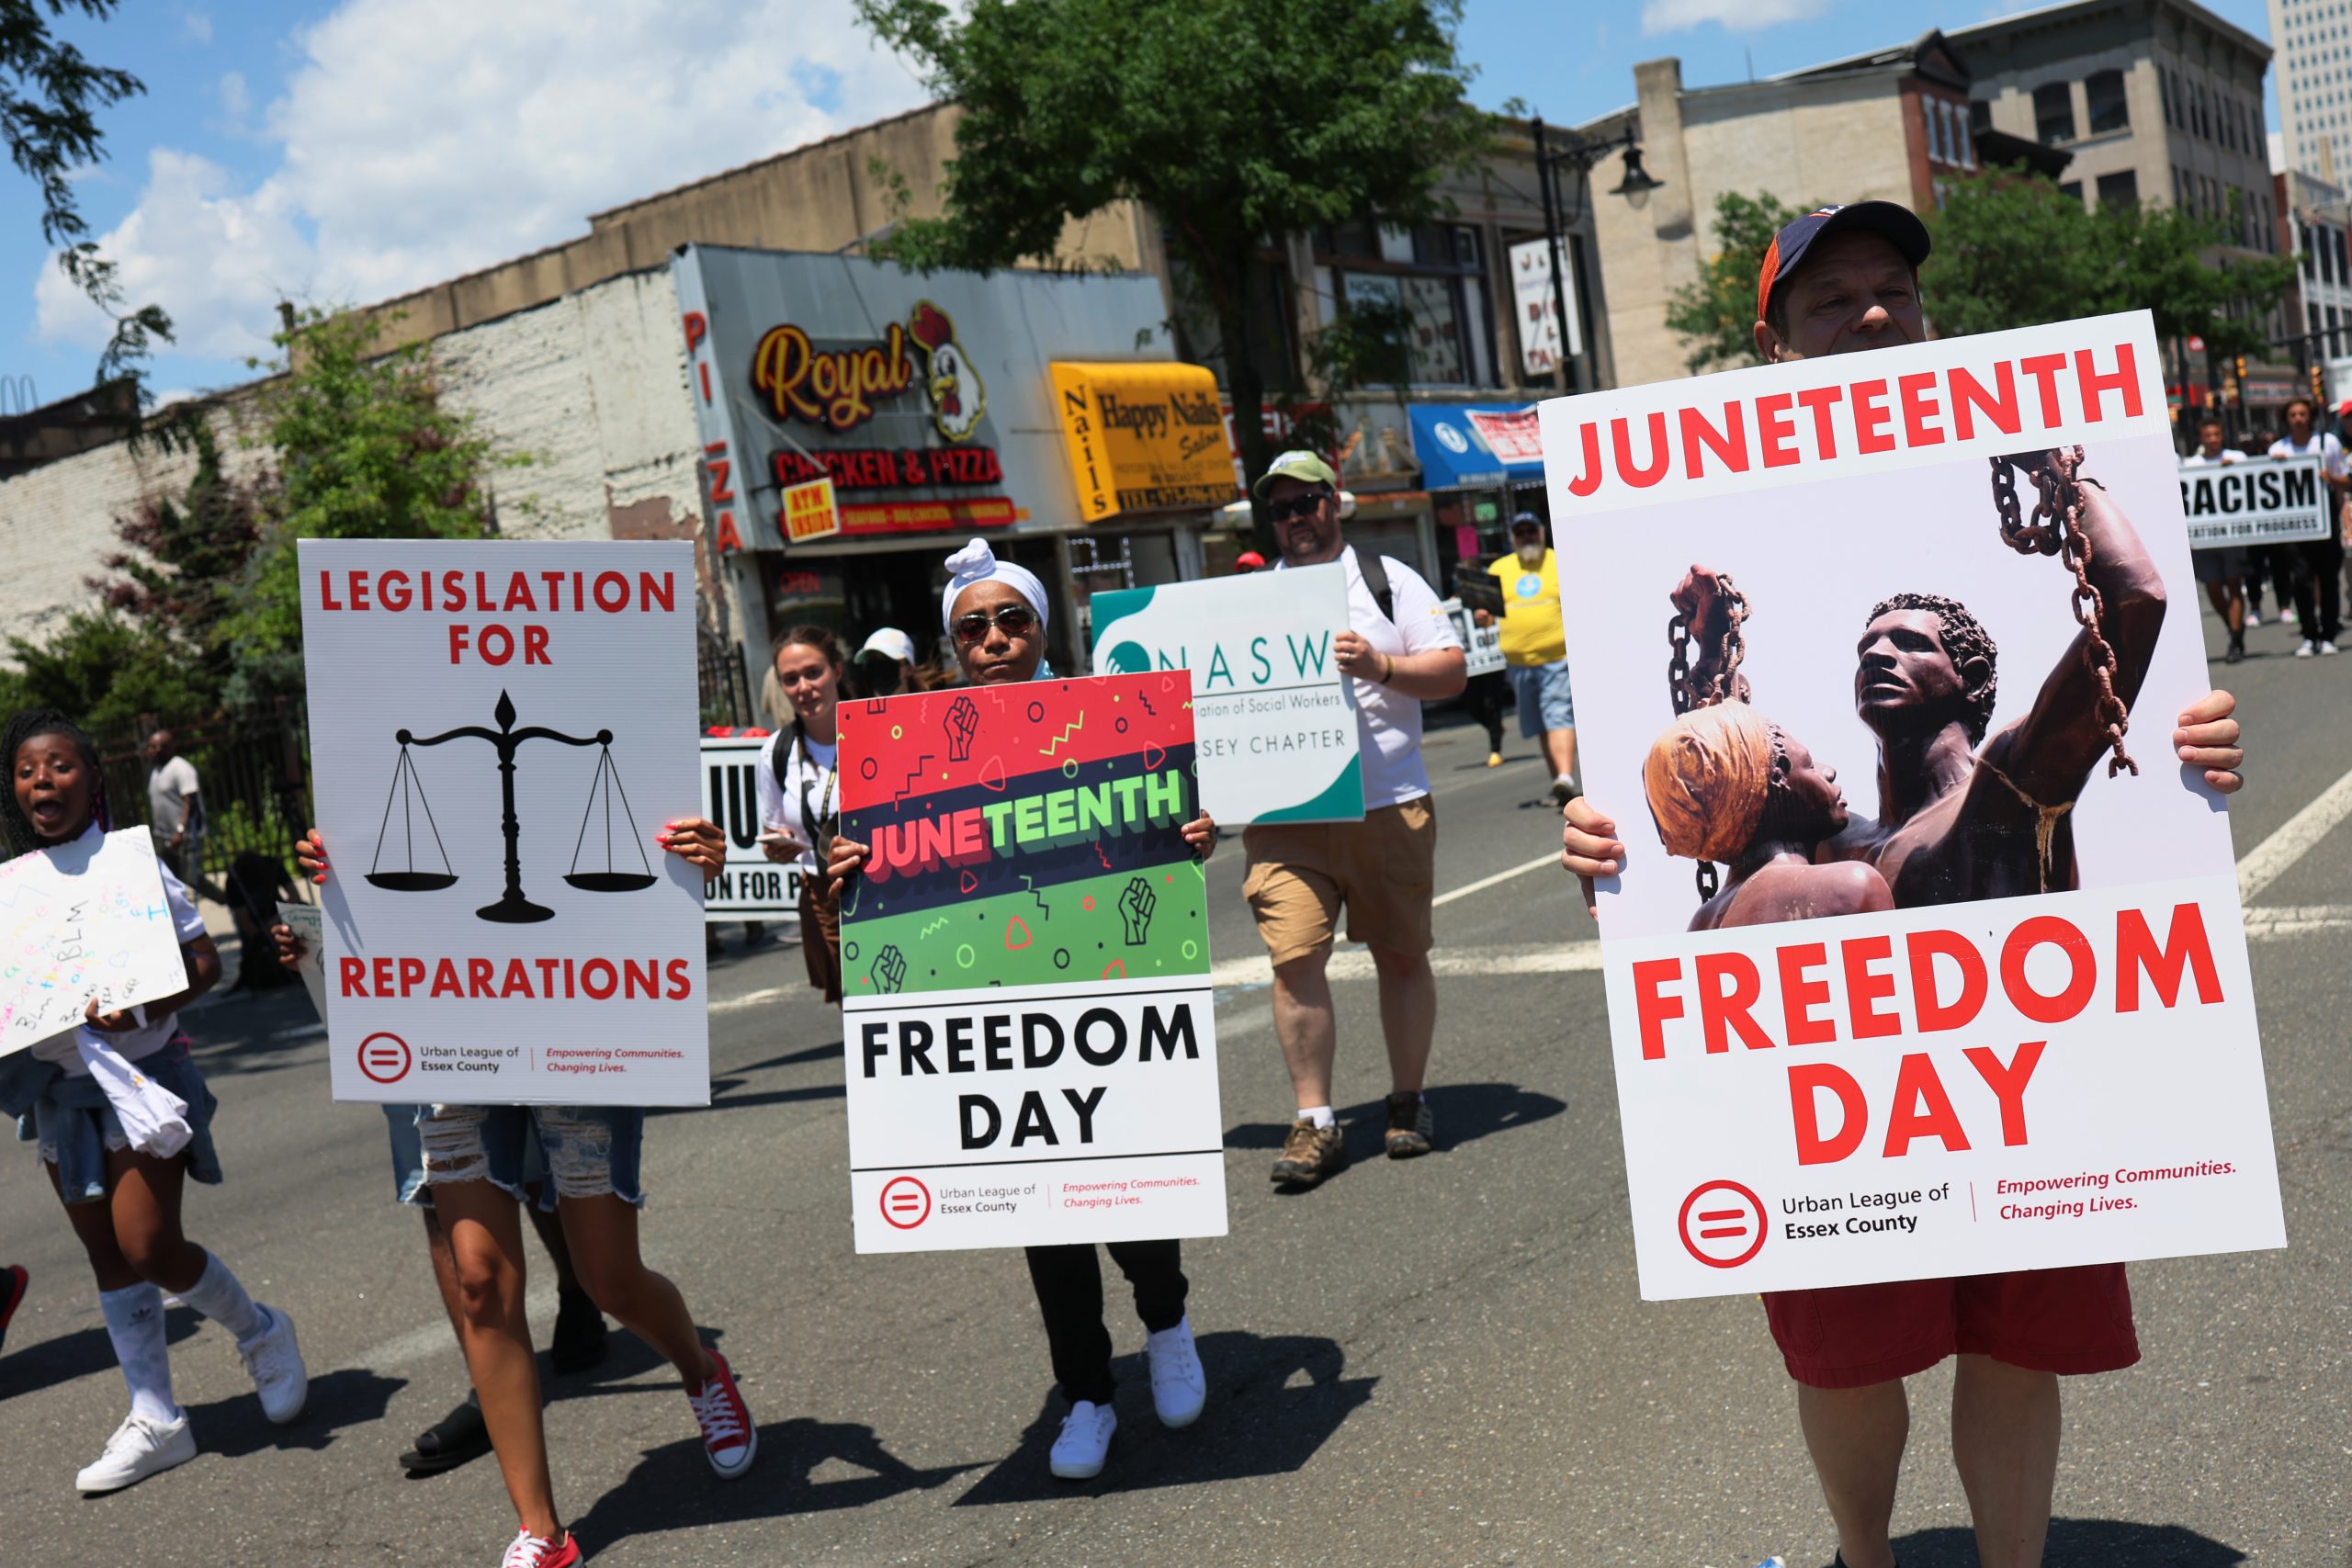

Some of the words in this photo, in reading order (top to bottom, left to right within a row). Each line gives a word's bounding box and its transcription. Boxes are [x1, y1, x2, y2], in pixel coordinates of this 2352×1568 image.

[753, 321, 911, 429] Royal
[684, 310, 744, 552] PIZA
[1098, 393, 1168, 439] Happy
[1169, 391, 1221, 426] Nails
[1567, 343, 2144, 497] JUNETEENTH
[1065, 385, 1107, 513] Nails
[776, 449, 899, 488] CHICKEN
[905, 451, 927, 485] &
[931, 447, 1004, 485] PIZZA
[791, 486, 823, 512] ATM
[2232, 521, 2253, 536] FOR
[321, 570, 674, 613] LEGISLATION
[449, 624, 553, 666] FOR
[1233, 699, 1245, 715] of
[1249, 696, 1286, 714] Social
[1291, 694, 1341, 710] Workers
[1250, 729, 1346, 755] CHAPTER
[864, 770, 1183, 875] JUNETEENTH
[740, 872, 782, 900] FOR
[57, 899, 89, 963] BLM
[339, 957, 692, 1001] REPARATIONS
[1633, 902, 2224, 1060] FREEDOM
[420, 1045, 458, 1058] Urban
[460, 1045, 503, 1060] League
[506, 1045, 520, 1058] of
[546, 1046, 613, 1061] Empowering
[615, 1046, 685, 1059] Communities.
[862, 1004, 1200, 1078] FREEDOM
[421, 1060, 454, 1072] Essex
[457, 1060, 500, 1075] County
[547, 1062, 597, 1075] Changing
[598, 1062, 628, 1073] Lives.
[958, 1087, 1108, 1150] DAY
[1787, 1041, 2047, 1166] DAY
[940, 1187, 976, 1200] Urban
[978, 1185, 1021, 1199] League
[1023, 1183, 1037, 1196] of
[1062, 1179, 1128, 1194] Empowering
[1130, 1176, 1201, 1190] Communities.
[1996, 1172, 2109, 1196] Empowering
[2115, 1159, 2237, 1184] Communities.
[941, 1202, 973, 1214] Essex
[976, 1201, 1017, 1213] County
[1064, 1196, 1113, 1209] Changing
[1114, 1194, 1144, 1206] Lives.
[1782, 1195, 1843, 1214] Urban
[1849, 1190, 1922, 1210] League
[1928, 1183, 1950, 1201] of
[1999, 1200, 2084, 1221] Changing
[2089, 1196, 2139, 1213] Lives.
[1785, 1219, 1840, 1239] Essex
[1846, 1213, 1918, 1234] County
